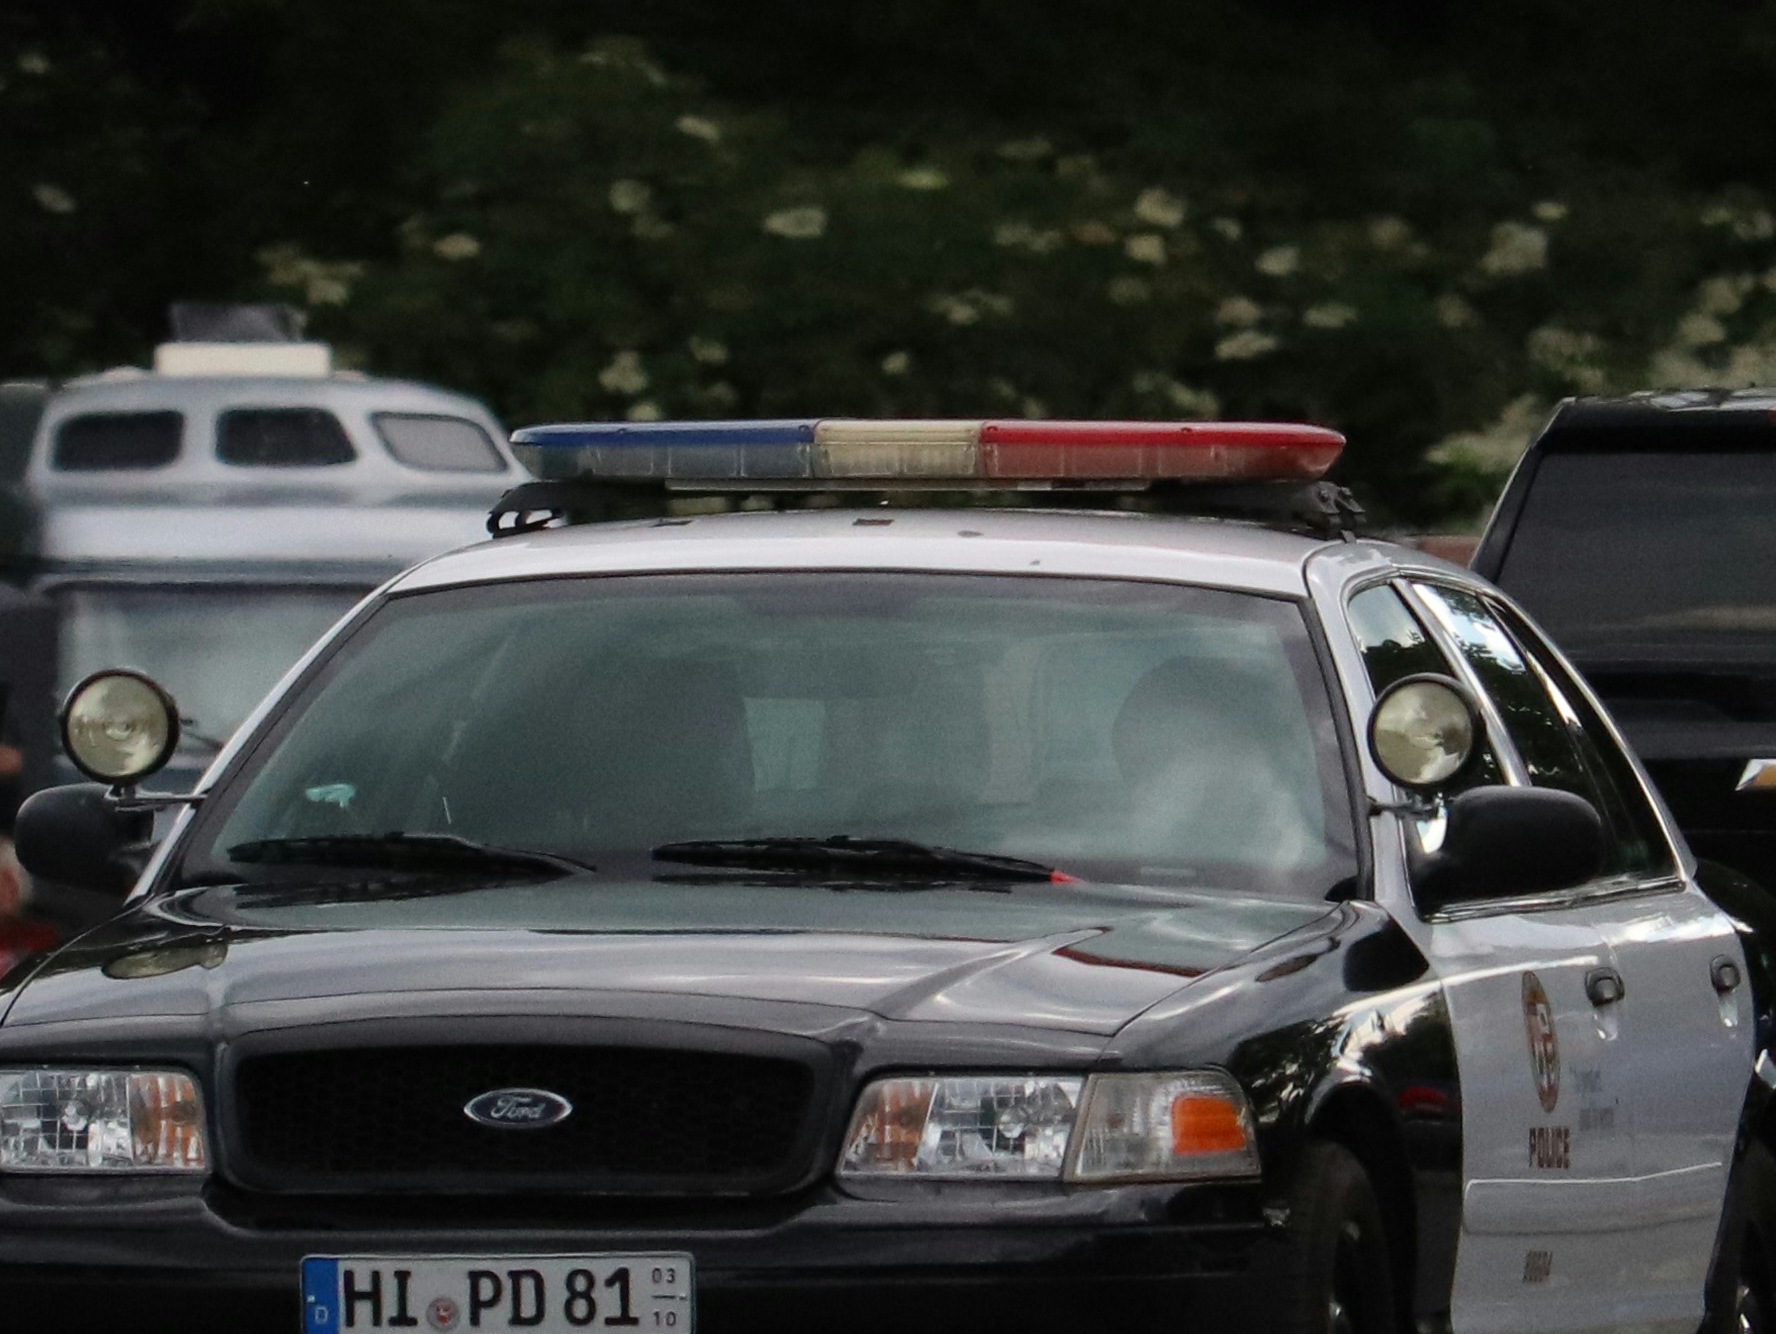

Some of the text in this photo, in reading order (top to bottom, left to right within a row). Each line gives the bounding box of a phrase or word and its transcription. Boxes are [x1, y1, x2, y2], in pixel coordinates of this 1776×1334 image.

[490, 1095, 546, 1119] Ford
[1529, 1127, 1570, 1169] POLICE
[651, 1268, 676, 1285] 03
[343, 1267, 639, 1328] HI PD 81
[652, 1311, 677, 1327] 10
